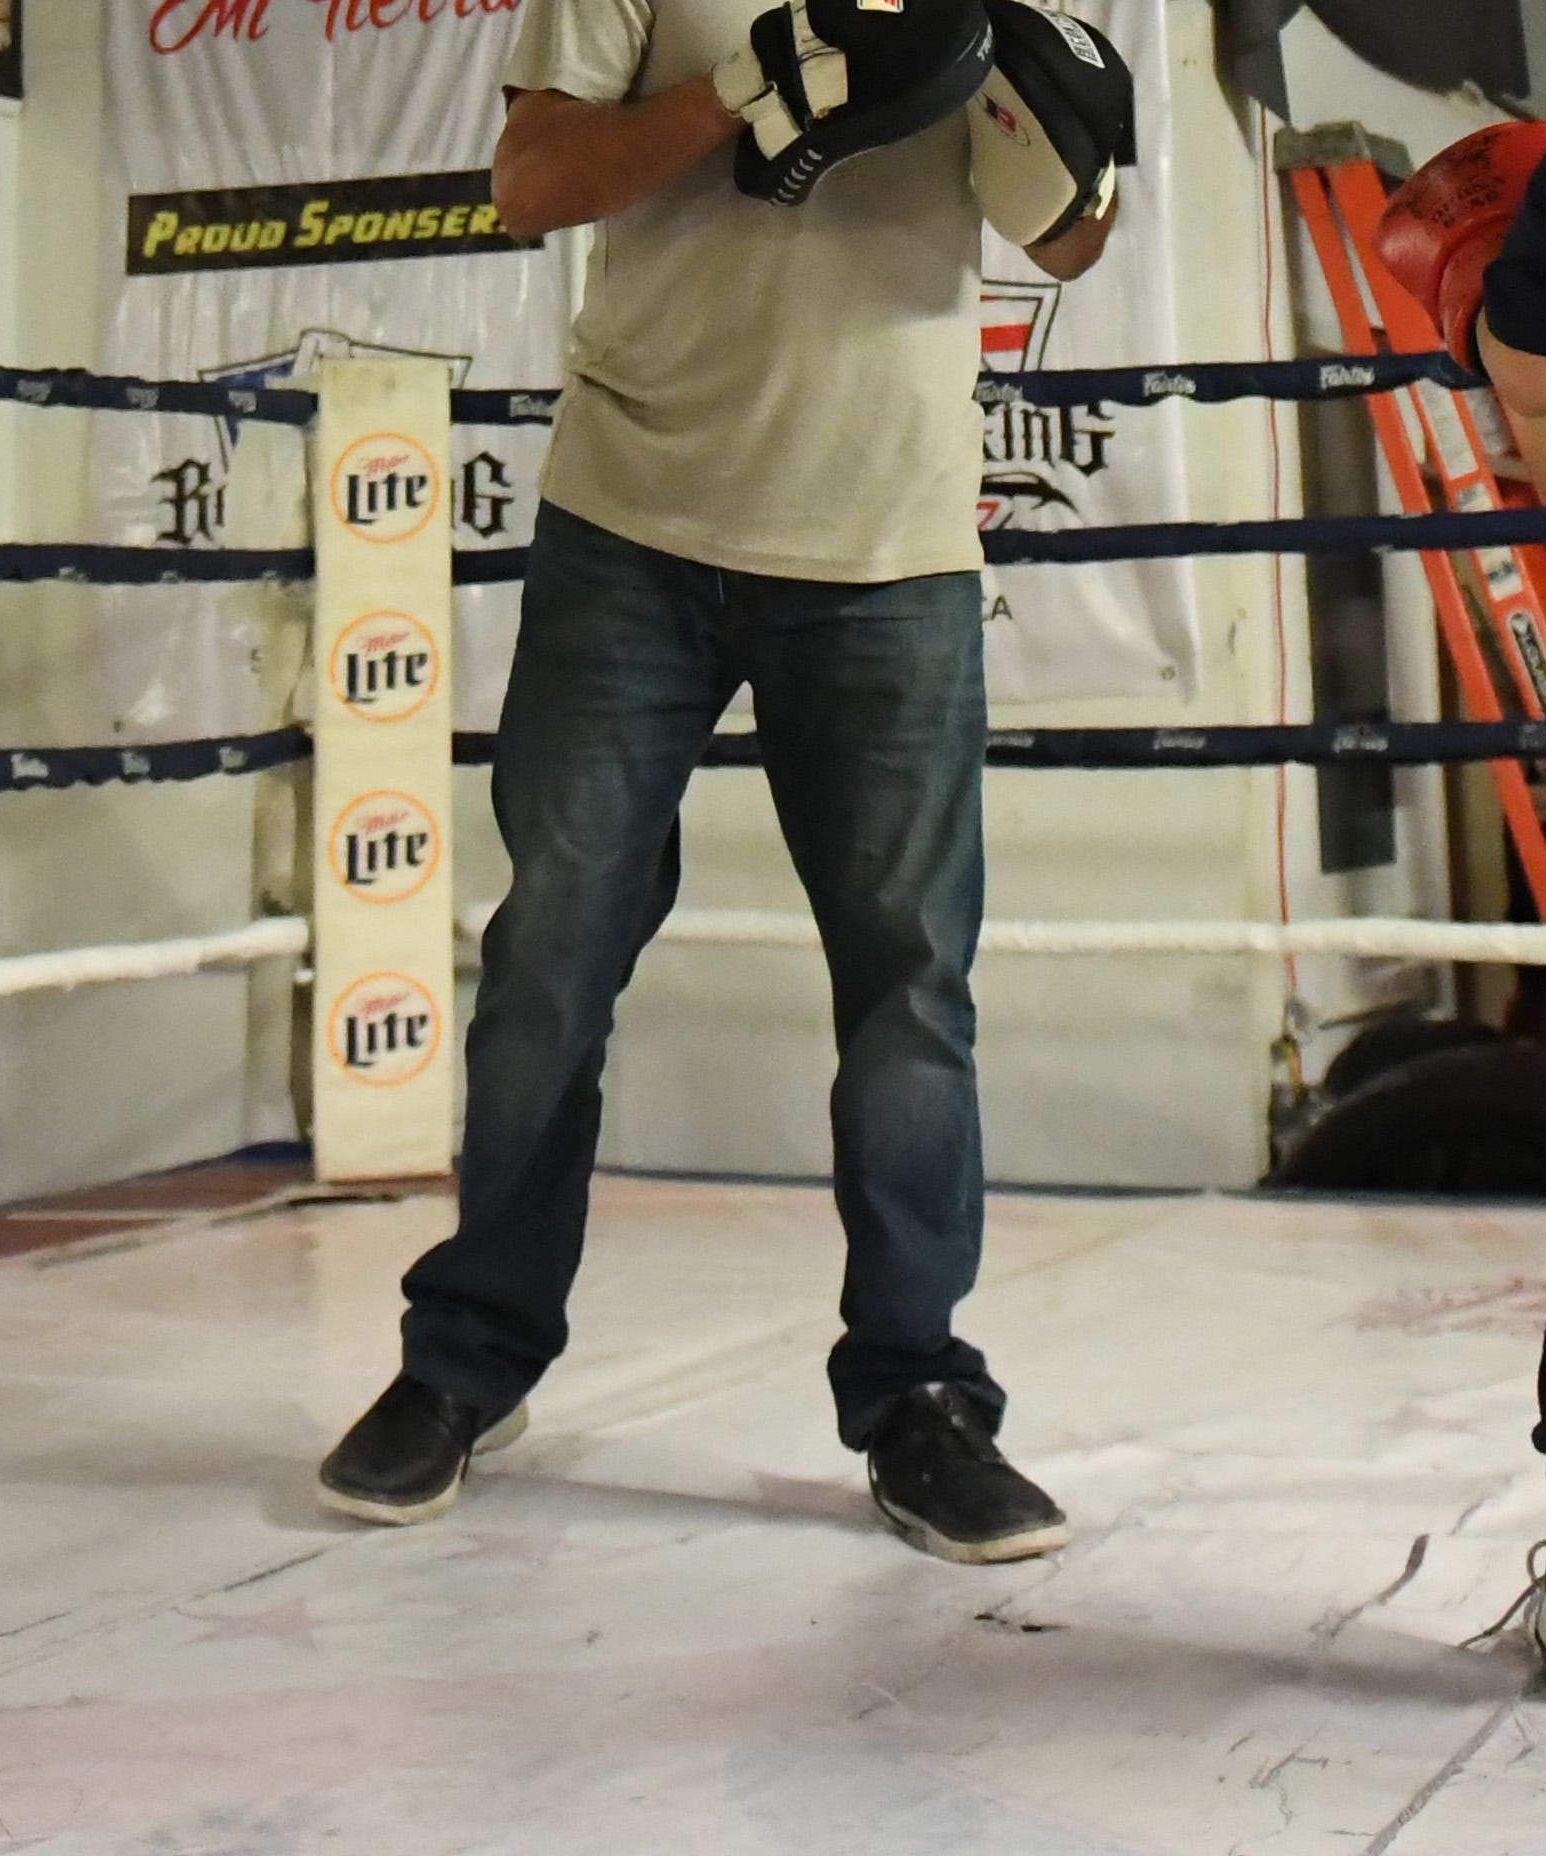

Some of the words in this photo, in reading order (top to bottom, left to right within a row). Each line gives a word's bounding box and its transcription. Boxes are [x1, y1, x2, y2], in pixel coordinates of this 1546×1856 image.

[344, 472, 428, 525] Lite
[344, 649, 428, 705] Lite
[344, 828, 429, 886] Lite
[344, 1010, 429, 1069] Lite
